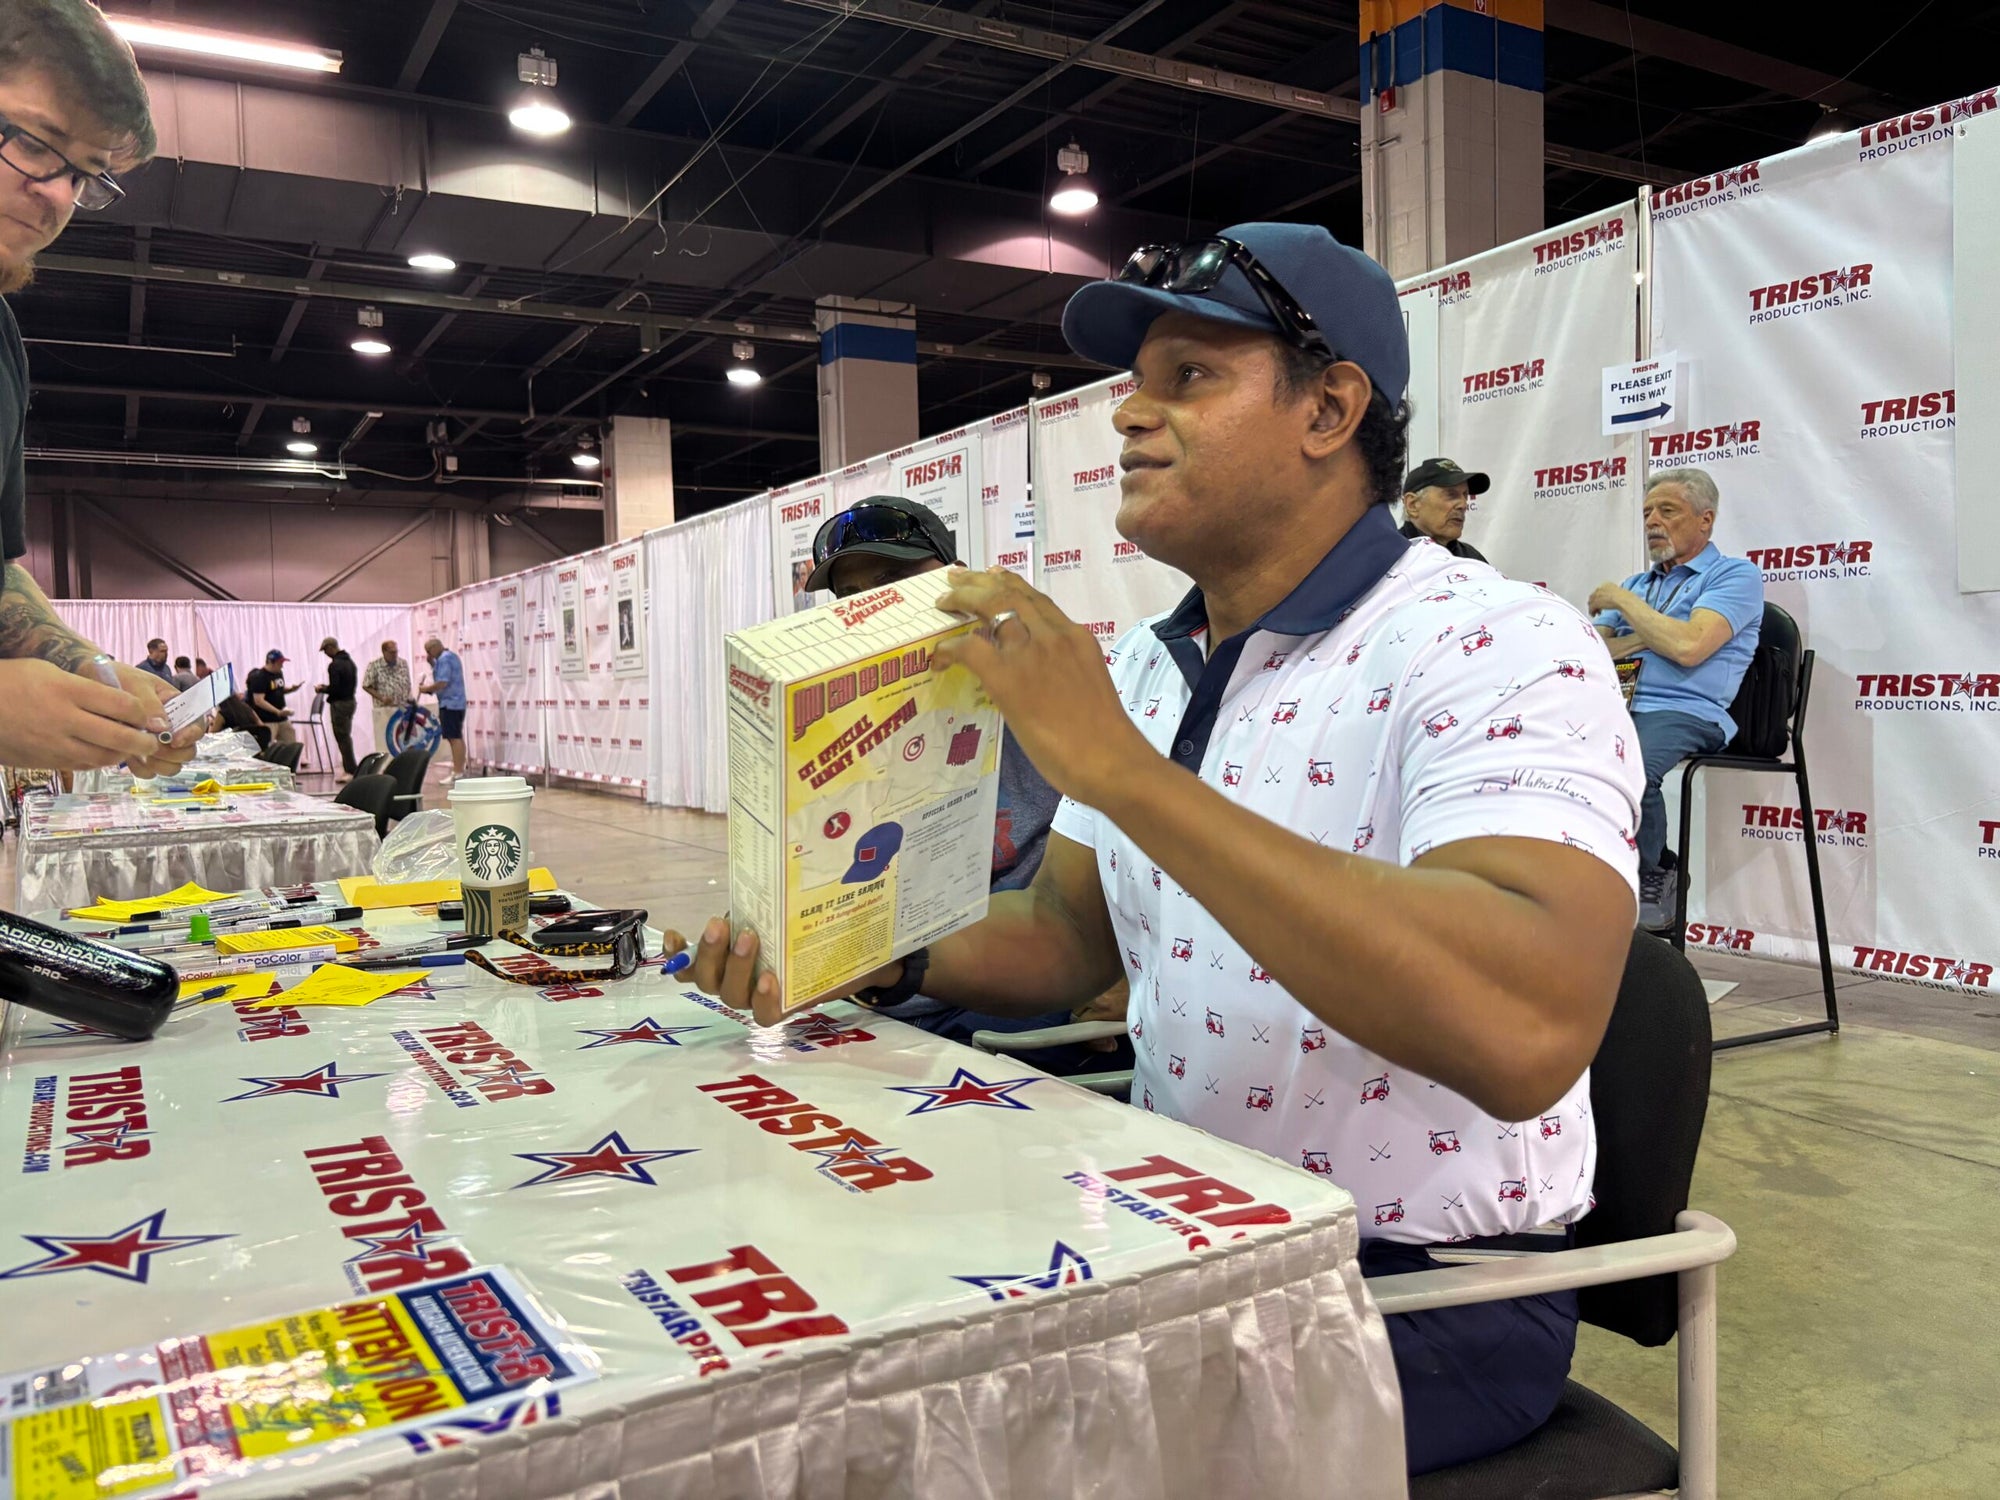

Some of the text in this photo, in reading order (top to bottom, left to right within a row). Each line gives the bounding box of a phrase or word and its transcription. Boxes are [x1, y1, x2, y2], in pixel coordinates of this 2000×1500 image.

[1859, 126, 1954, 162] PRODUCTION
[1652, 183, 1764, 222] PRODUCTIONS, INC.
[1534, 240, 1625, 277] PRODUCTIONS, INC.
[1749, 289, 1872, 325] PRODUCTIONS, INC.
[1462, 379, 1545, 405] PRODUCTIONS, INC.
[1611, 370, 1673, 392] PLEASE EXIT
[1620, 386, 1667, 405] THIS WAY
[1861, 389, 1955, 425] TRIST
[1861, 416, 1955, 439] PRODUCTION
[1649, 444, 1761, 469] PRODUCTIONS, INC.
[1534, 478, 1627, 500] PRODUCTIONS, INC.
[1760, 566, 1871, 583] ODUCTIONS, INC.
[1855, 700, 2000, 712] PRODUCTIONS, INC.
[1741, 827, 1868, 848] PRODUCTNS, INC.
[334, 1301, 450, 1421] ATTENTION
